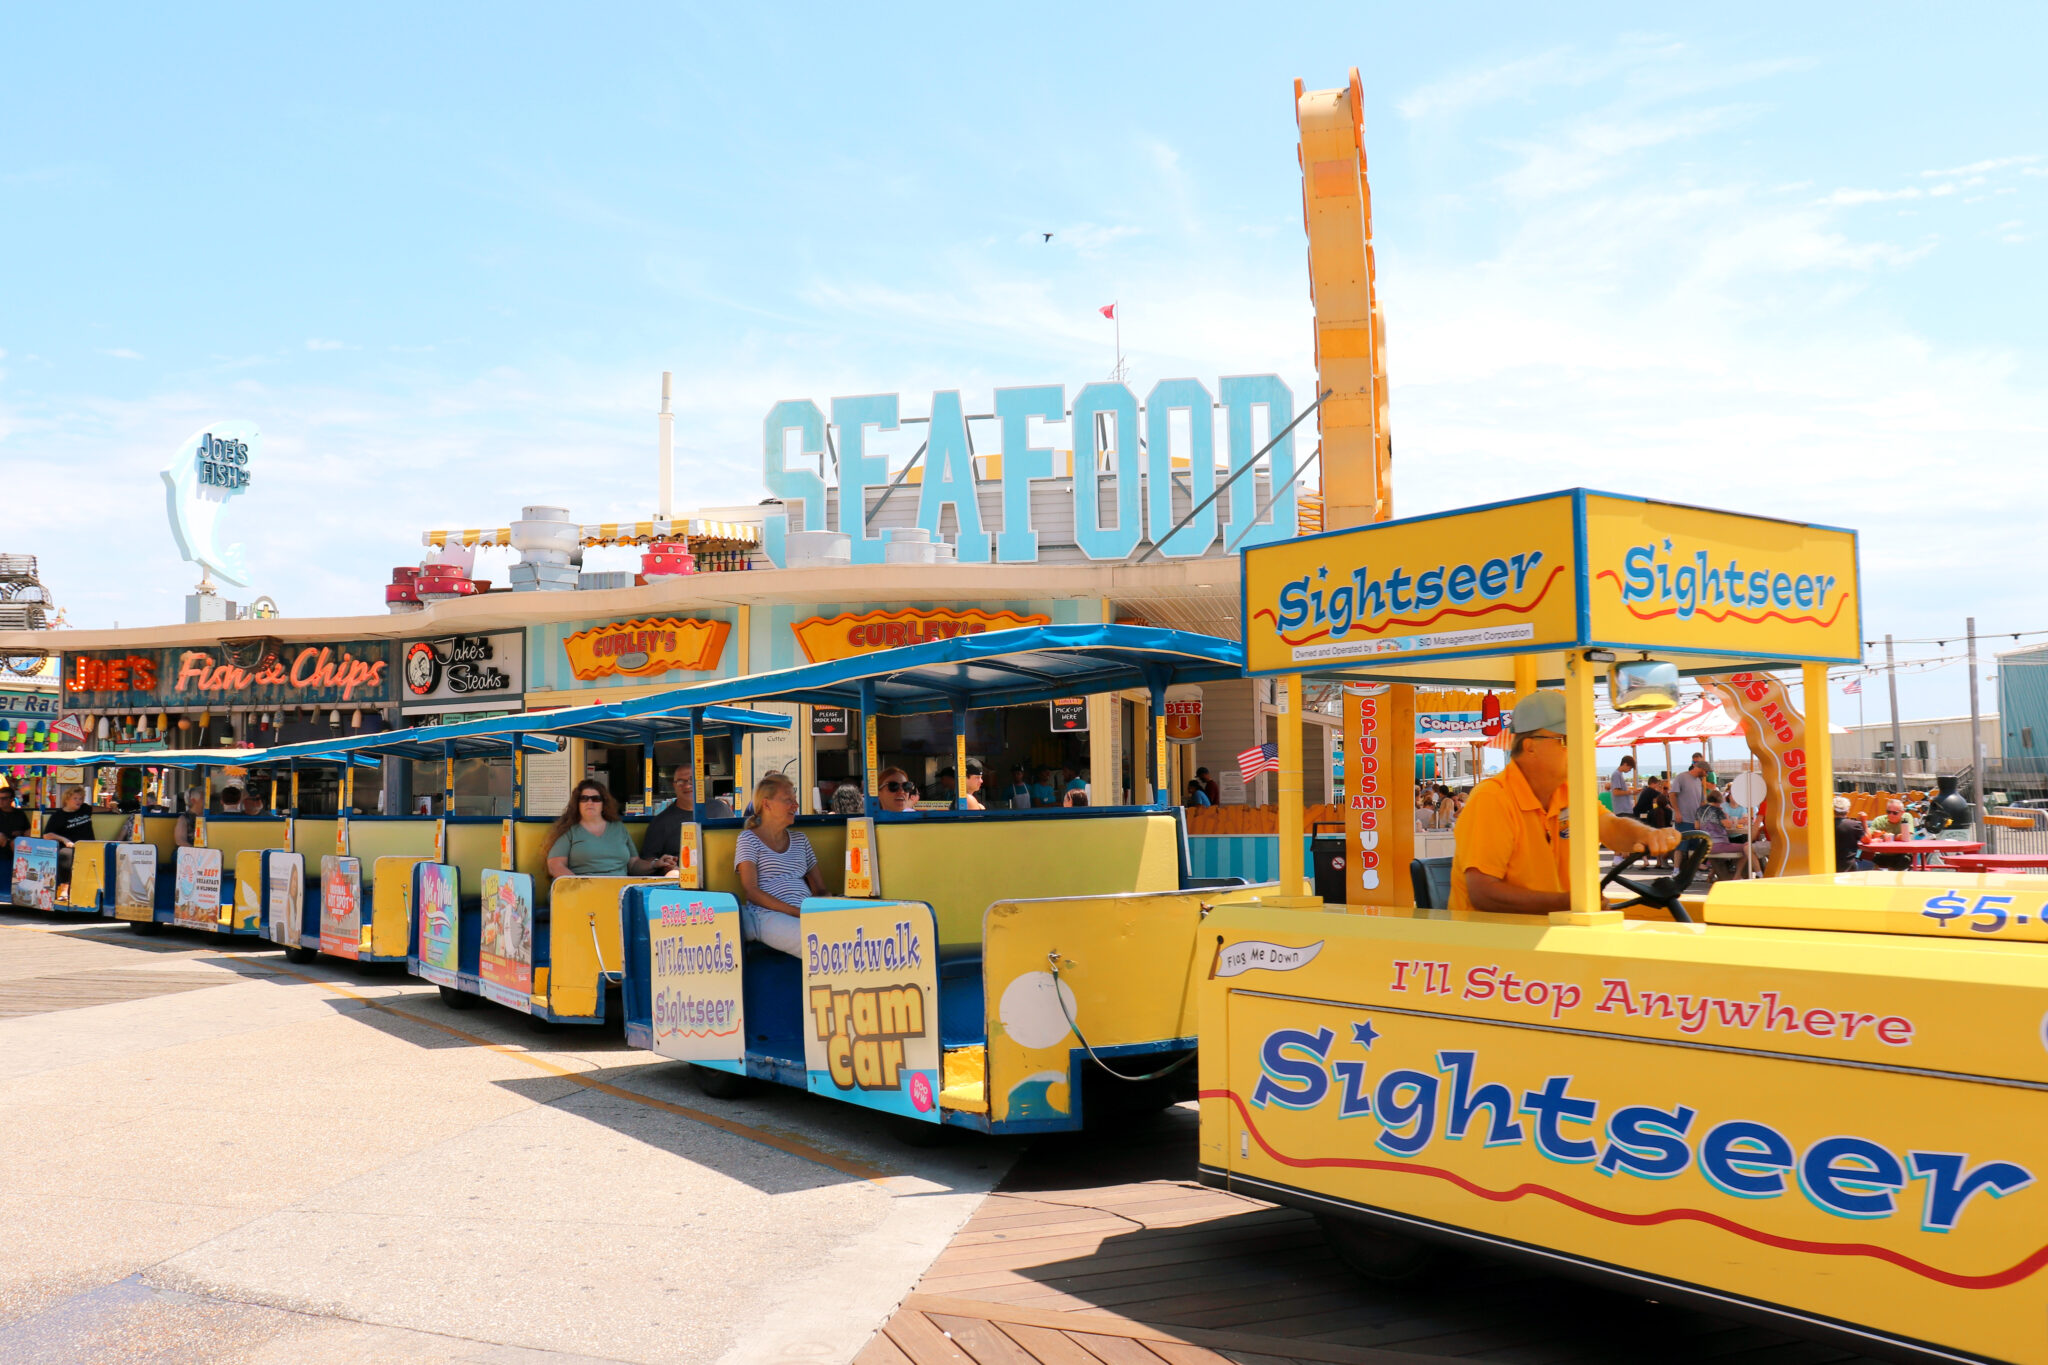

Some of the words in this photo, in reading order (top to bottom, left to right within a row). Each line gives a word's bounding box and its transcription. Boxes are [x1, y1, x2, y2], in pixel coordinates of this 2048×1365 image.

[198, 432, 249, 466] JOE'S
[763, 372, 1299, 568] SEAFOOD
[200, 460, 240, 489] FISH
[1275, 549, 1544, 639] Sightseer
[1621, 537, 1837, 621] Sightseer
[434, 636, 488, 665] Jake's
[593, 630, 677, 658] CURLEY'S
[1295, 648, 1317, 659] Owned
[1319, 647, 1330, 657] and
[1332, 644, 1363, 656] Operated
[1364, 643, 1372, 654] by
[1419, 637, 1431, 647] SID
[1433, 633, 1482, 647] Management
[1484, 627, 1531, 642] Corporation
[65, 655, 158, 693] JOE'S
[175, 650, 254, 692] Fish
[290, 646, 388, 701] Chips
[447, 664, 504, 693] Steaks
[1165, 701, 1203, 714] BEER
[1760, 702, 1795, 744] AND
[1359, 697, 1379, 795] SPUDS
[1351, 795, 1386, 810] AND
[203, 868, 219, 878] BEST
[660, 904, 687, 927] Ride
[689, 901, 715, 925] The
[655, 932, 735, 976] Wildwoods
[807, 920, 923, 975] Boardwalk
[1227, 952, 1247, 968] Flag
[1251, 948, 1265, 961] Me
[1269, 948, 1300, 964] Down
[655, 986, 735, 1036] Sightseer
[809, 983, 926, 1041] Tram
[1390, 959, 1452, 996] I'll
[1463, 964, 1582, 1019] Stop
[1596, 976, 1916, 1047] Anywhere
[827, 1034, 907, 1091] Car
[1250, 1019, 2033, 1234] Sightseer
